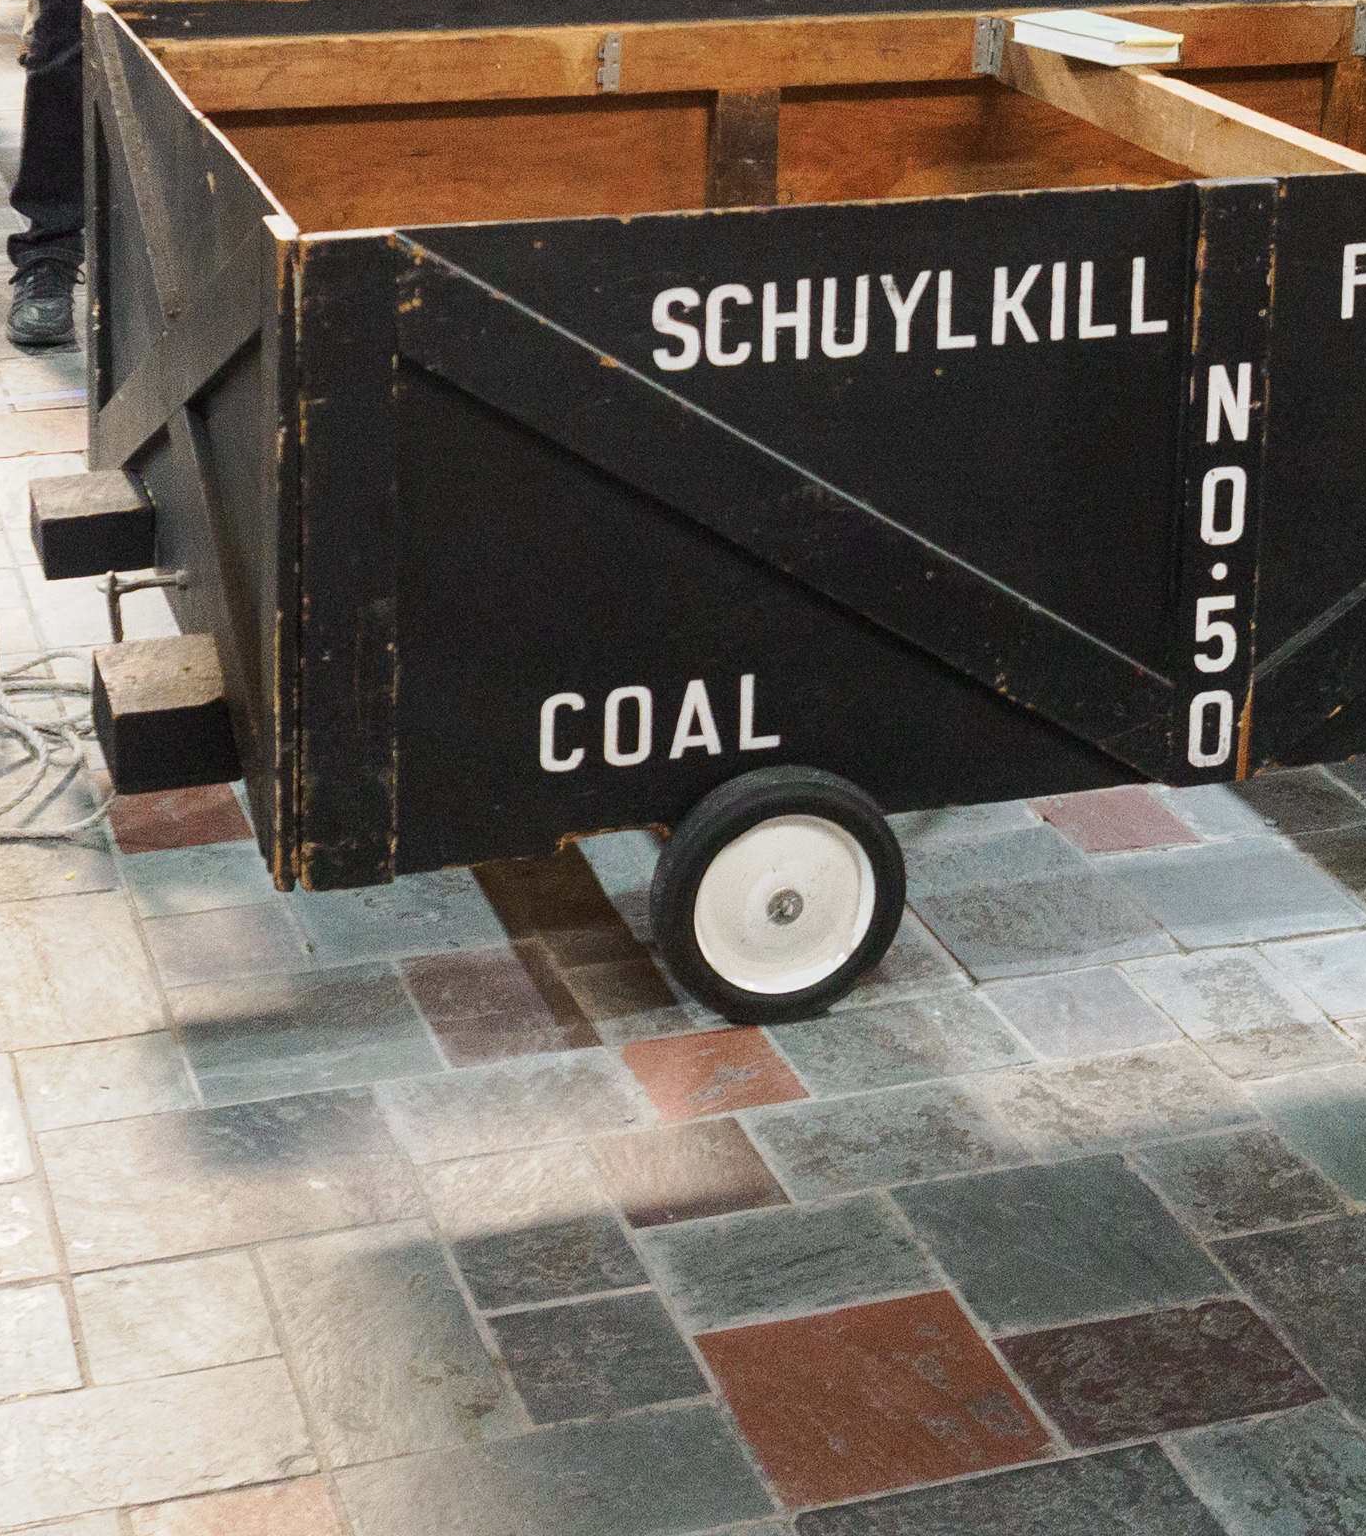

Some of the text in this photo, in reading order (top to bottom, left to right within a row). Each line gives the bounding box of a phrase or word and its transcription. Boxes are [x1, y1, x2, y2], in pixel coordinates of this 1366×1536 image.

[651, 256, 1168, 371] SCHUYLKILL
[1187, 362, 1252, 769] NO.50
[539, 674, 780, 772] COAL
